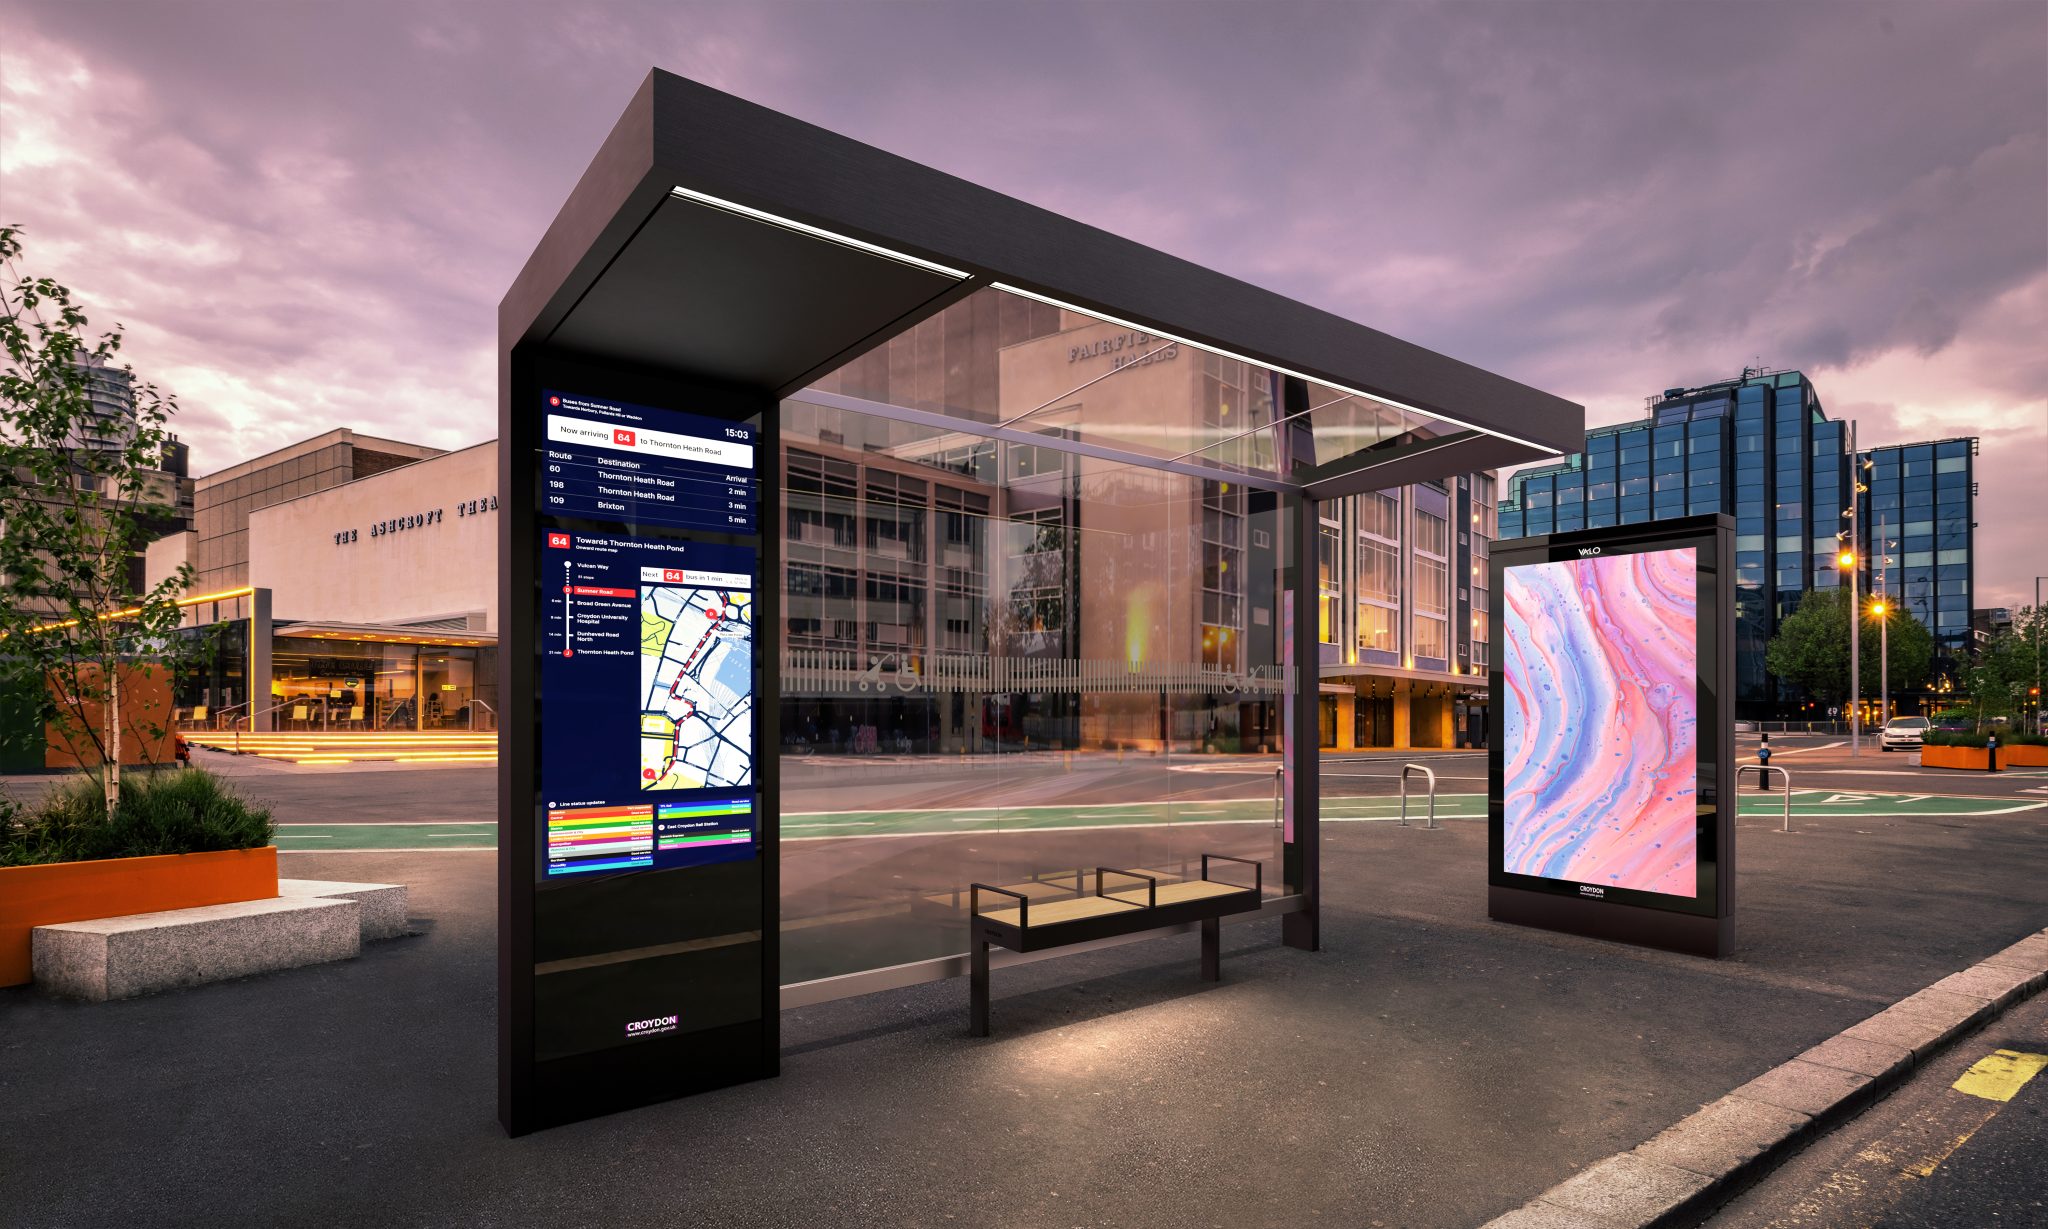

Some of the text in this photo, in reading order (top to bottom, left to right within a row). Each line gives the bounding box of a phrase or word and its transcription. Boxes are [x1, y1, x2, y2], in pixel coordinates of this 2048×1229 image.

[1068, 331, 1160, 363] FAIRFIE
[590, 402, 608, 410] Sumner
[560, 426, 578, 435] Now
[580, 429, 609, 440] arriving
[617, 433, 630, 443] 64
[649, 439, 682, 450] Thornton
[683, 444, 704, 453] Heath
[704, 447, 722, 456] Road
[725, 428, 749, 440] 15:03
[549, 450, 748, 484] Route Destination Arrival
[549, 465, 561, 473] 60
[597, 470, 632, 482] Thornton
[633, 476, 656, 485] Heath
[656, 478, 675, 487] Road
[728, 487, 733, 495] 2
[549, 480, 747, 510] 198 Thornton Heath Road 3 min
[549, 496, 747, 524] 109 Brixton 5 min
[333, 529, 358, 545] THE
[370, 509, 443, 537] ASHCROFT
[552, 537, 567, 546] 64
[576, 536, 608, 546] Towards
[609, 540, 643, 549] Thornton
[644, 543, 665, 551] Heath
[1578, 546, 1601, 556] VALO
[666, 572, 680, 581] 64
[627, 1015, 676, 1031] CROYDON
